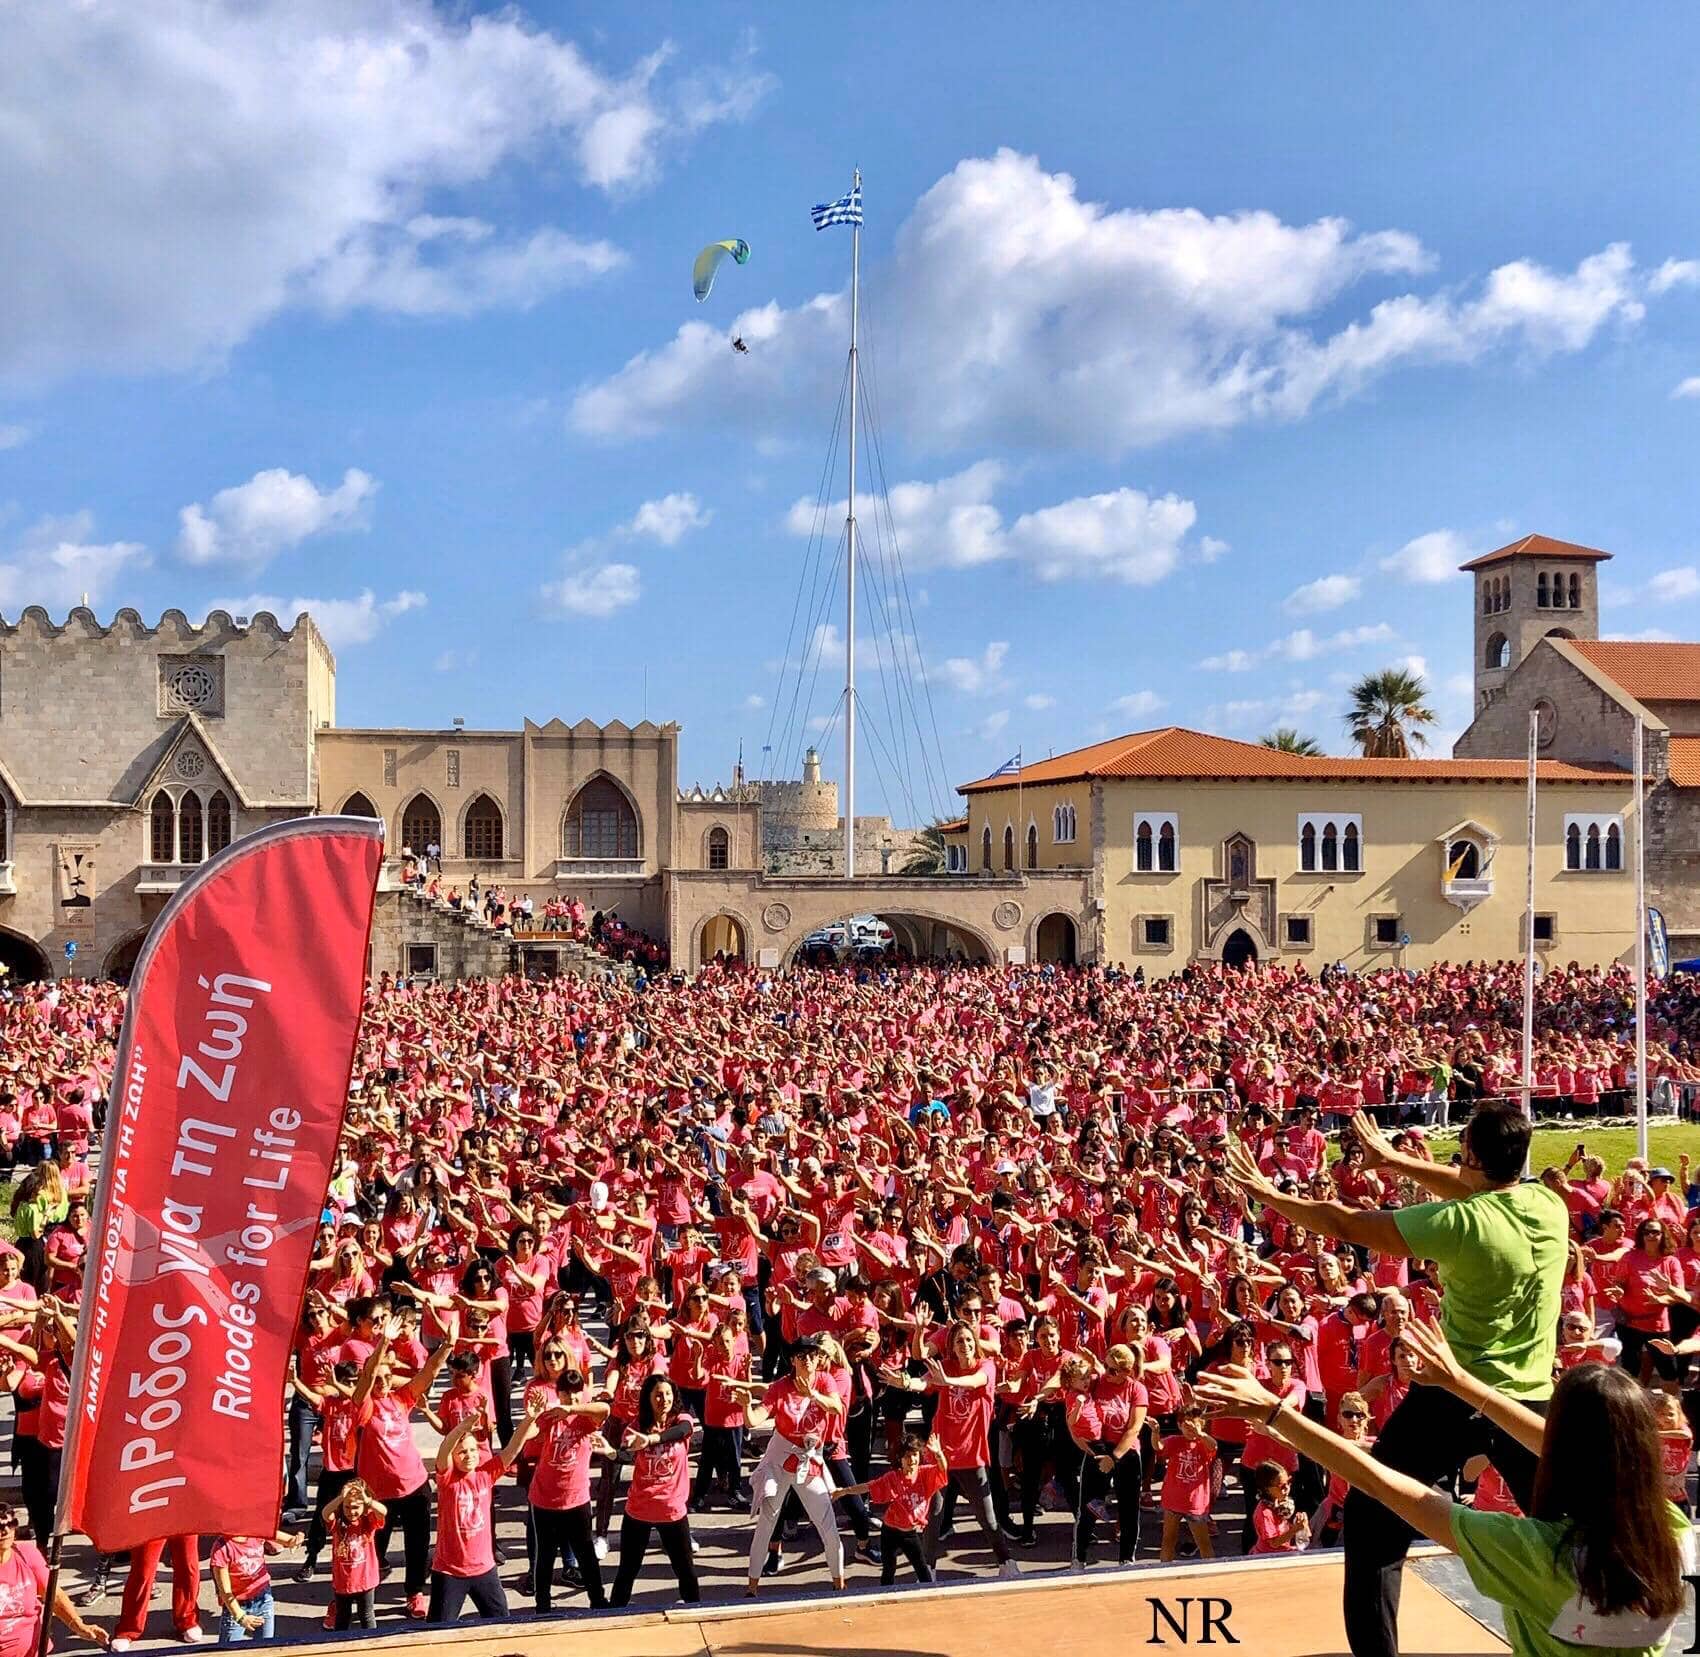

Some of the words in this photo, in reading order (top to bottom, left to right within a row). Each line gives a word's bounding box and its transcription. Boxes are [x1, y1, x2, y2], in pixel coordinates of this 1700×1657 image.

[176, 973, 272, 1102] Ζωή
[119, 1127, 135, 1159] ΤΗ
[171, 1118, 237, 1176] τη
[242, 1107, 302, 1190] Life
[113, 1168, 128, 1209] ΓΙΑ
[99, 1212, 123, 1303] ΡΟΔΟΣ
[158, 1197, 210, 1276] για
[226, 1203, 278, 1267] for
[119, 1303, 208, 1472] Ρόδος
[212, 1280, 261, 1420] Rhodes
[128, 1476, 187, 1514] η
